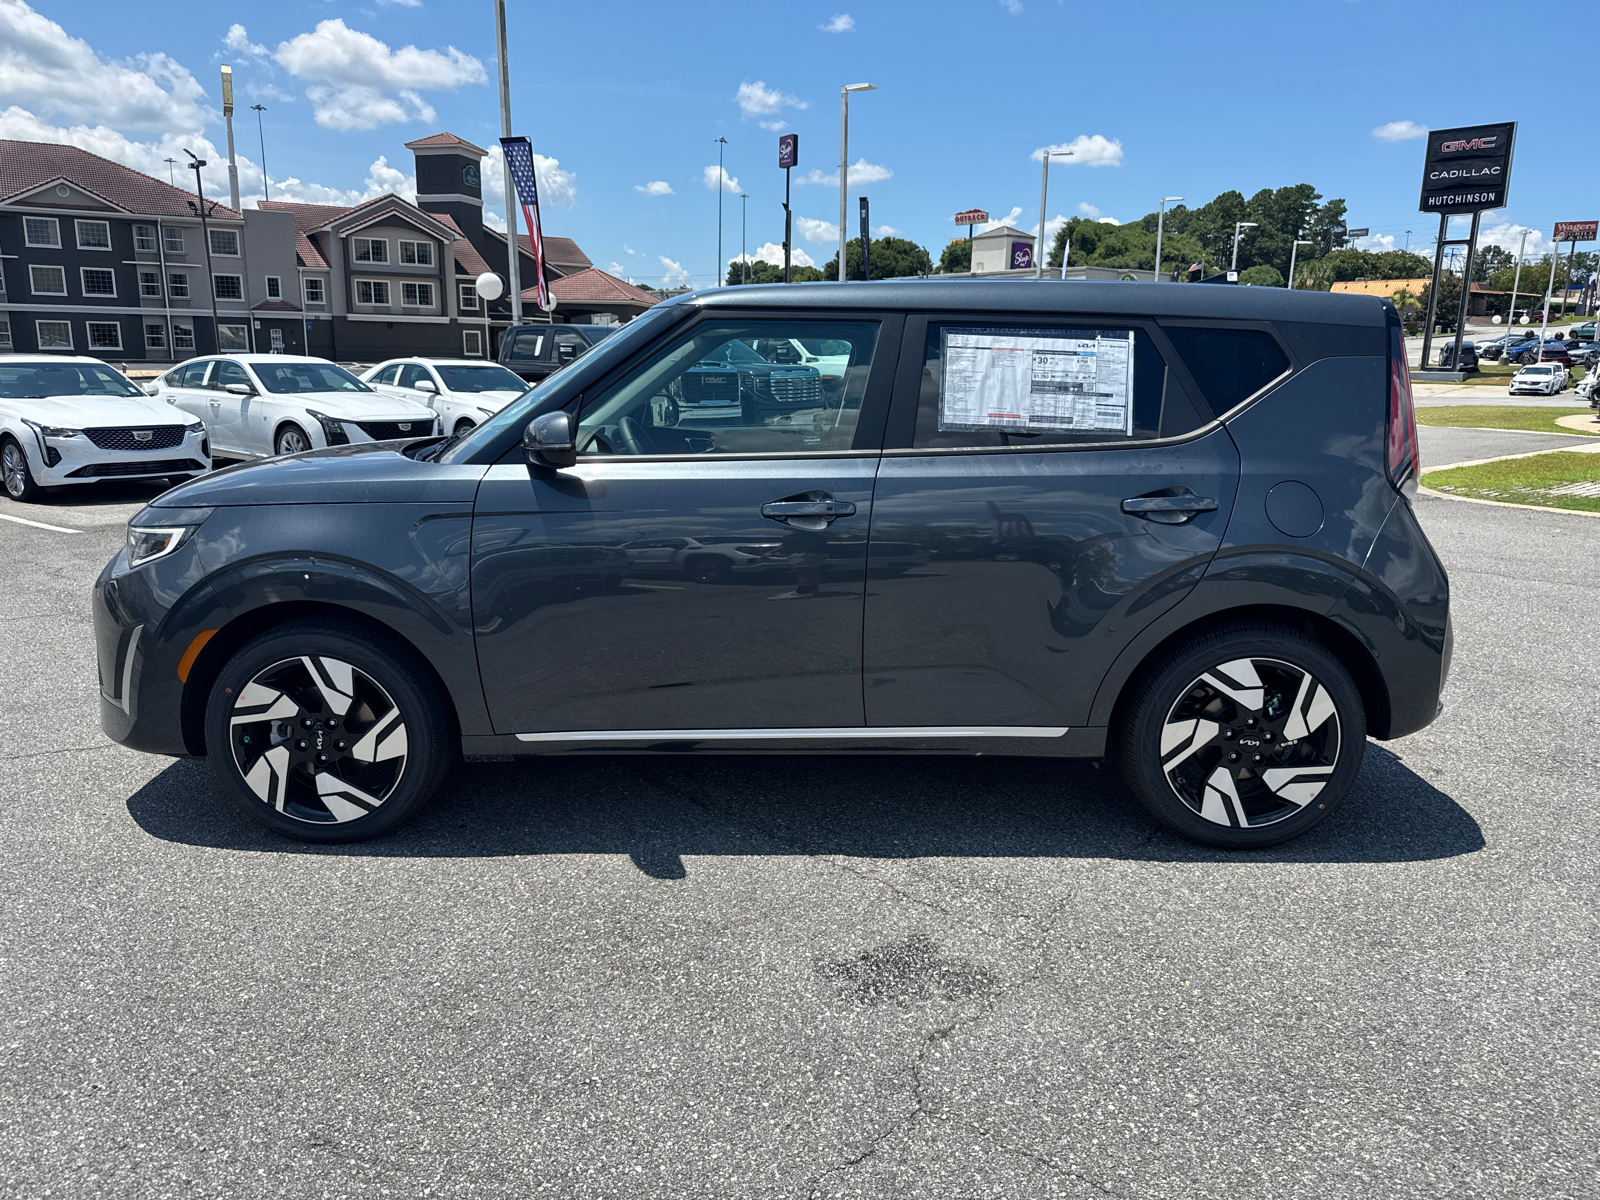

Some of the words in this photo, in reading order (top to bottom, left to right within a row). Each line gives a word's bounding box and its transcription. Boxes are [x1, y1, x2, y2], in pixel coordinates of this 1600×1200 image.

[1441, 136, 1497, 152] GMC
[1430, 166, 1501, 179] CADILLAC
[1428, 192, 1496, 206] HUTCHINSON
[955, 214, 985, 222] OUTBACK
[1557, 223, 1596, 231] Wagers
[1037, 356, 1049, 365] 30
